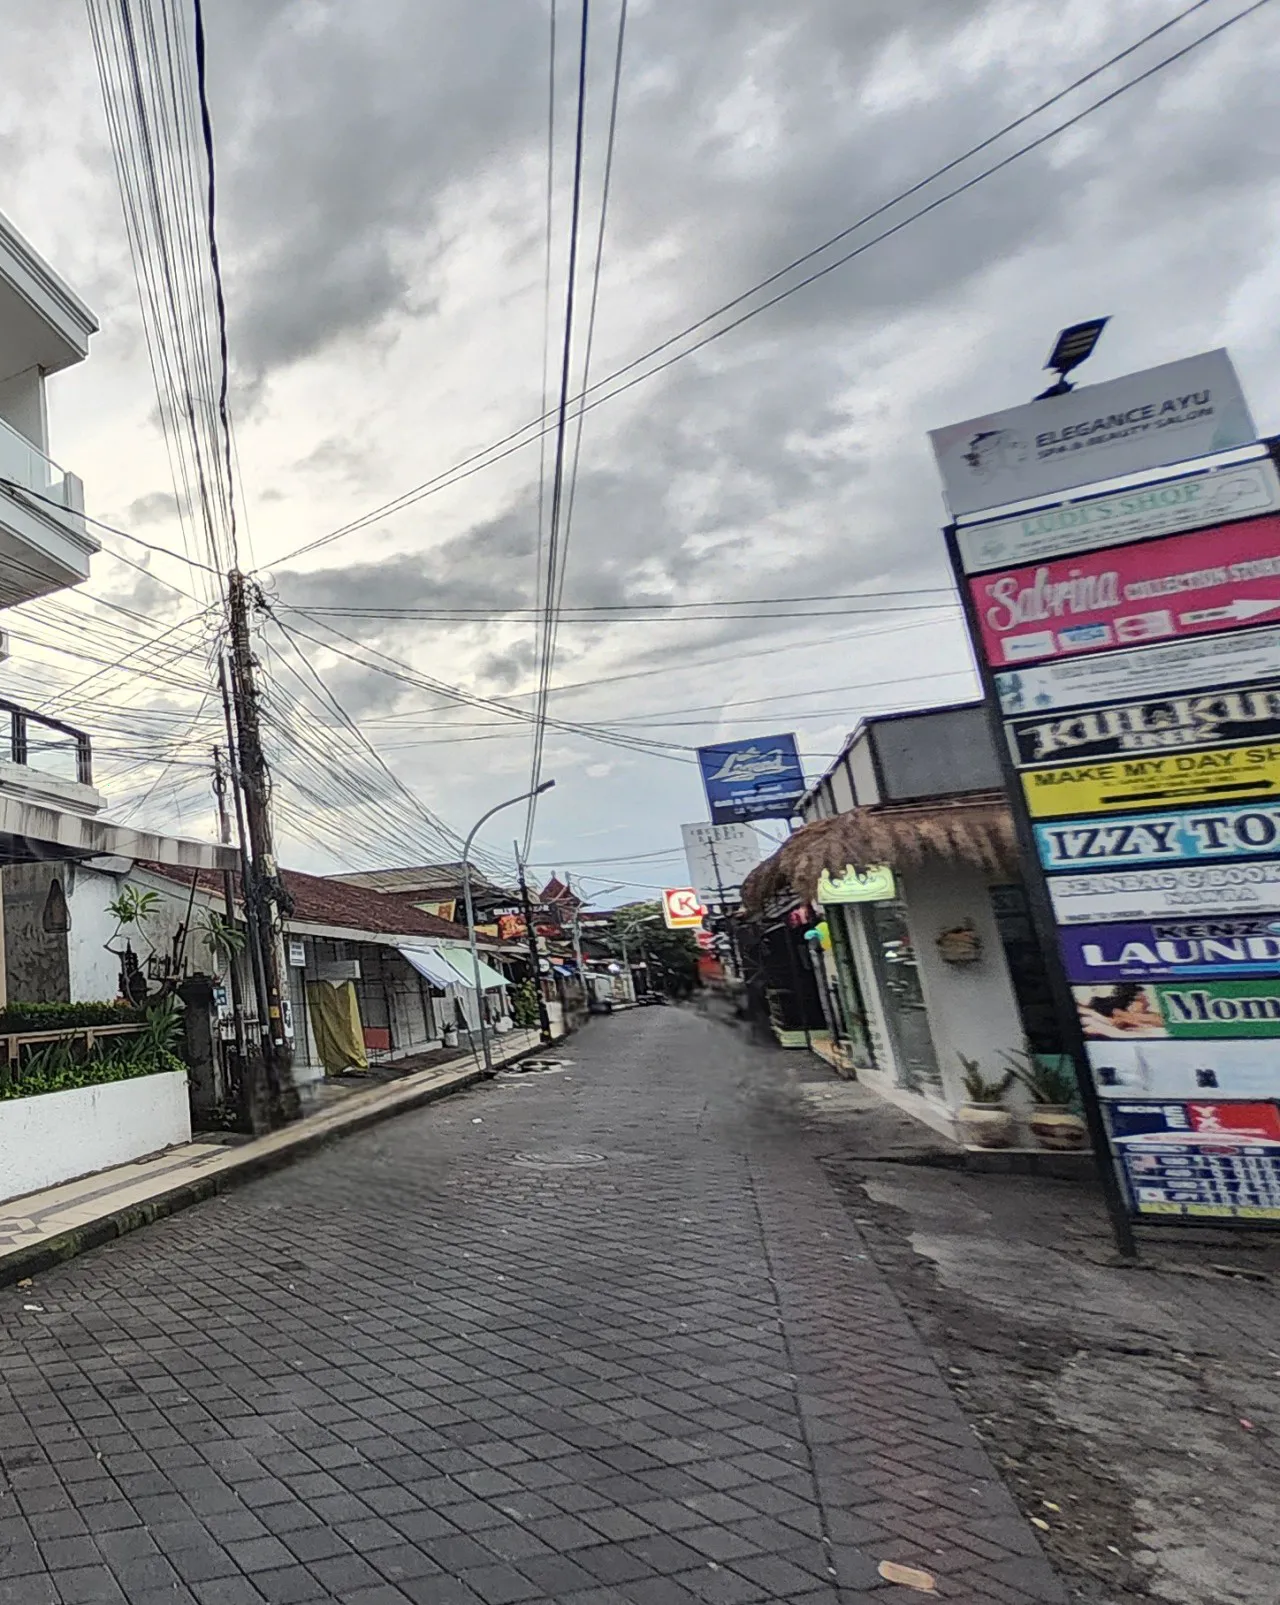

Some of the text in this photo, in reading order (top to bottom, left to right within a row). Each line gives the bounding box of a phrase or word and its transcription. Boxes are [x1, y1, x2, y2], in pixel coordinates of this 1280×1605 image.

[1035, 389, 1211, 448] ELEGANCE AYU
[1086, 424, 1150, 446] BEAUTY
[1155, 407, 1214, 429] SALON
[1120, 483, 1203, 514] SHOP
[985, 566, 1121, 632] Sabrina
[1018, 690, 1280, 759] KULKU
[1034, 766, 1116, 786] MAKE
[1123, 760, 1166, 776] MY
[1176, 752, 1236, 771] DAY
[1048, 812, 1280, 860] IZZY TO
